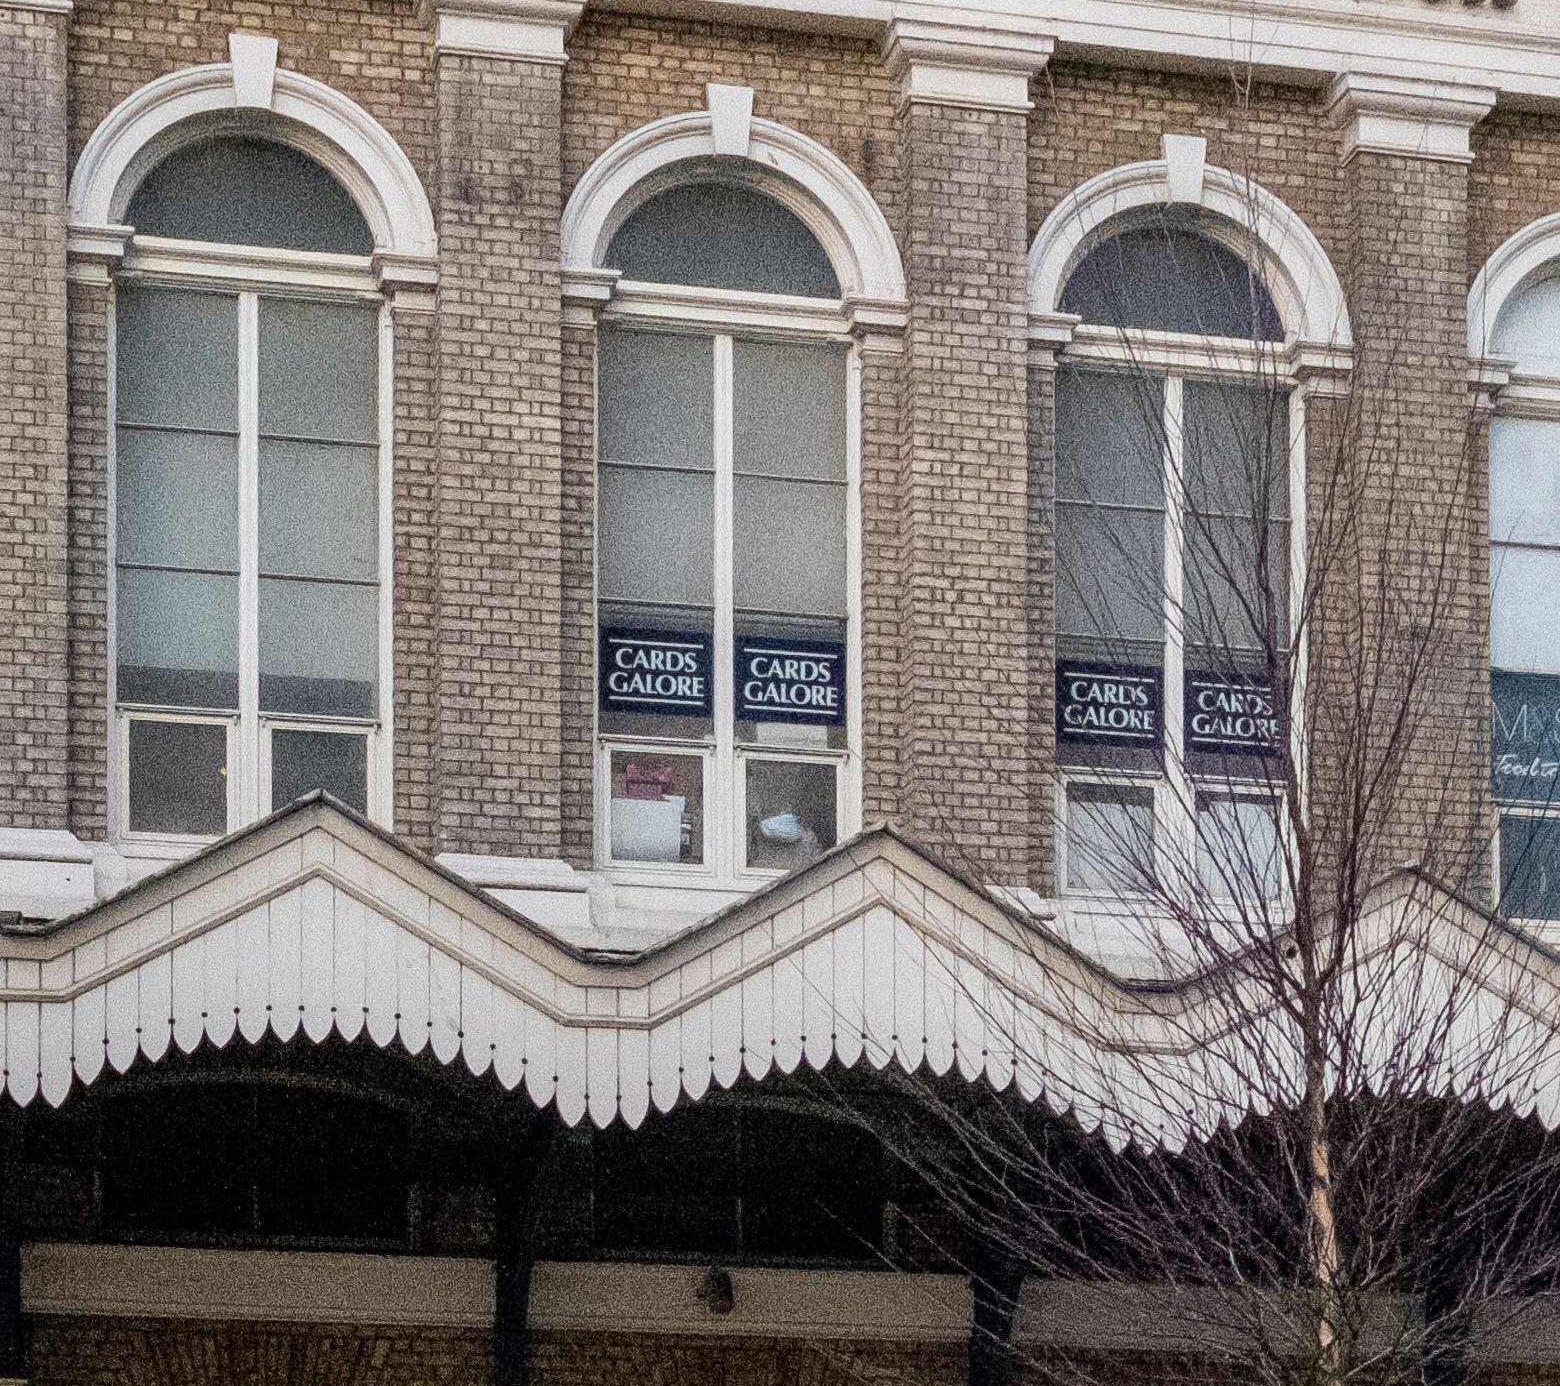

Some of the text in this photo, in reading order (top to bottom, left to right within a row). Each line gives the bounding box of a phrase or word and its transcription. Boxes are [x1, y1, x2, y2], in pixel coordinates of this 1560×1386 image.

[614, 645, 698, 674] CARDS
[748, 654, 832, 683] CARDS
[608, 671, 705, 700] GALORE
[743, 680, 838, 709] GALORE
[1069, 678, 1150, 707] CARDS
[1197, 687, 1274, 717] CARDS
[1065, 704, 1156, 732] GALORE
[1191, 712, 1279, 741] GALORE
